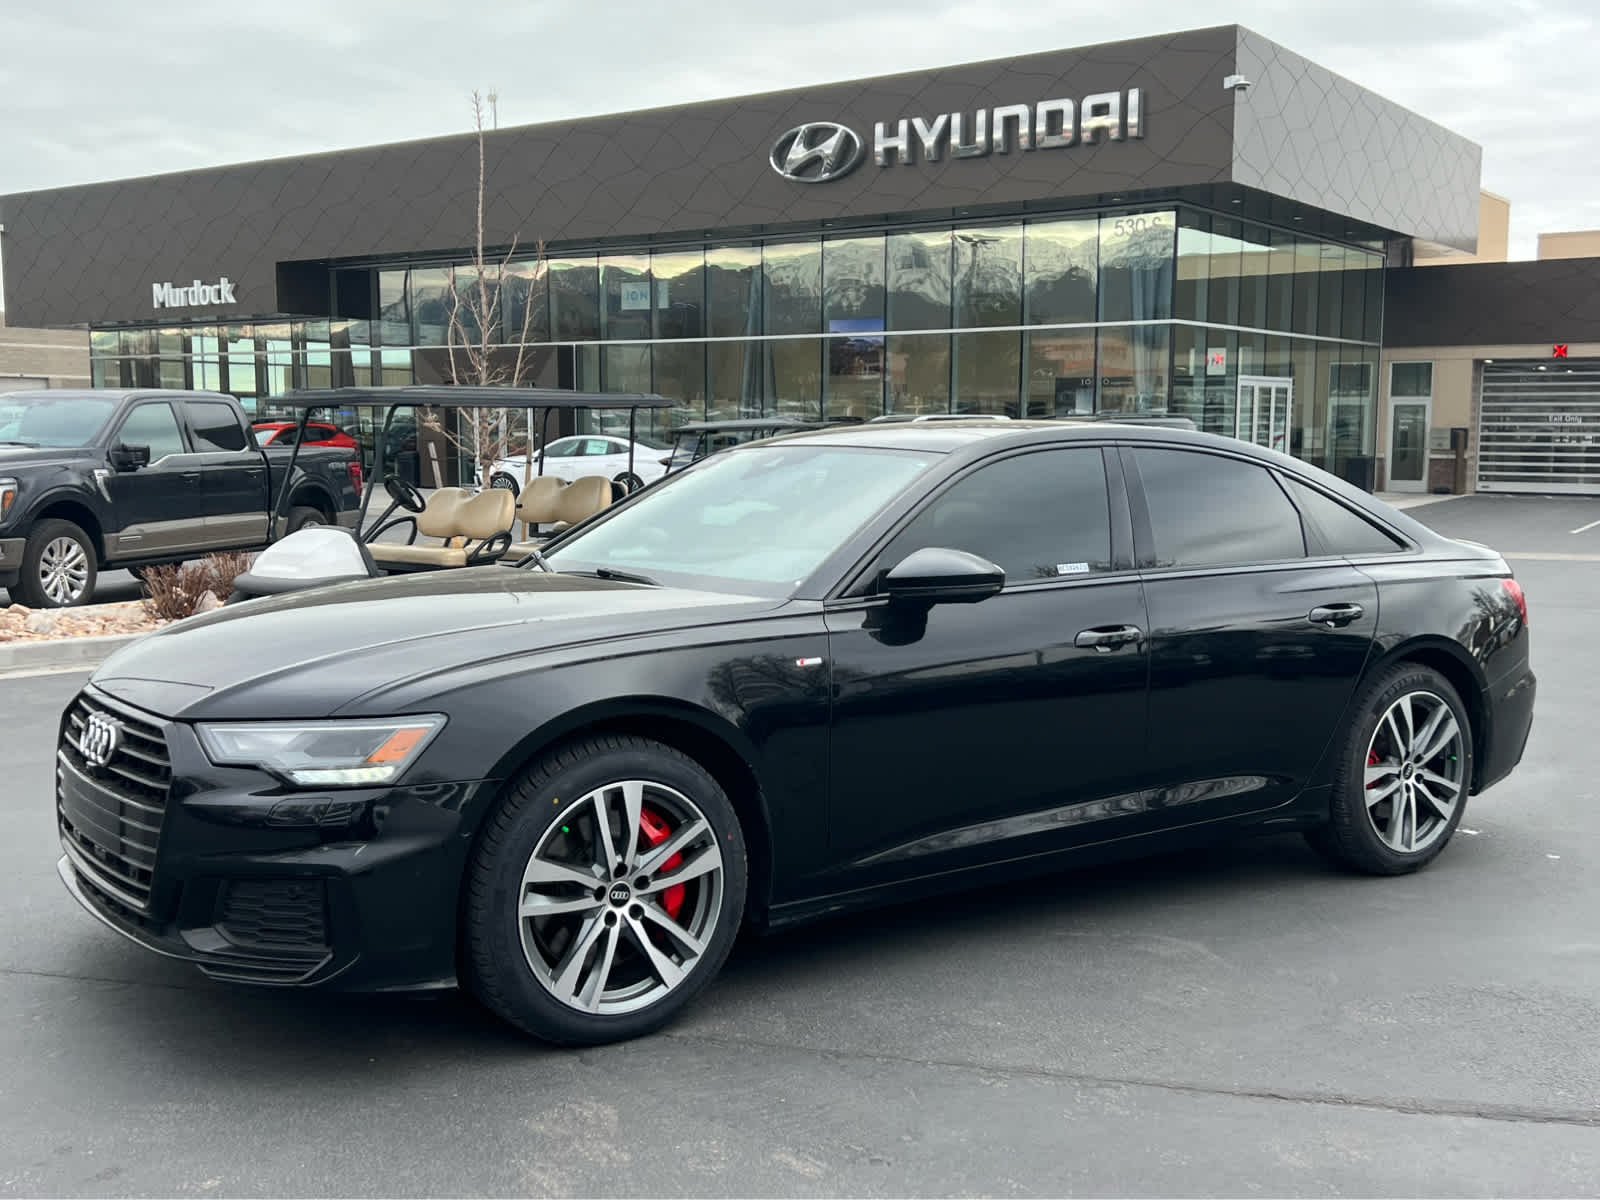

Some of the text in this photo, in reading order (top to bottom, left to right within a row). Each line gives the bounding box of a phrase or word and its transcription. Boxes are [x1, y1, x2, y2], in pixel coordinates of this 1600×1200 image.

[874, 88, 1144, 168] HYUNDAI
[1114, 217, 1146, 237] 530
[152, 277, 237, 308] Murdock
